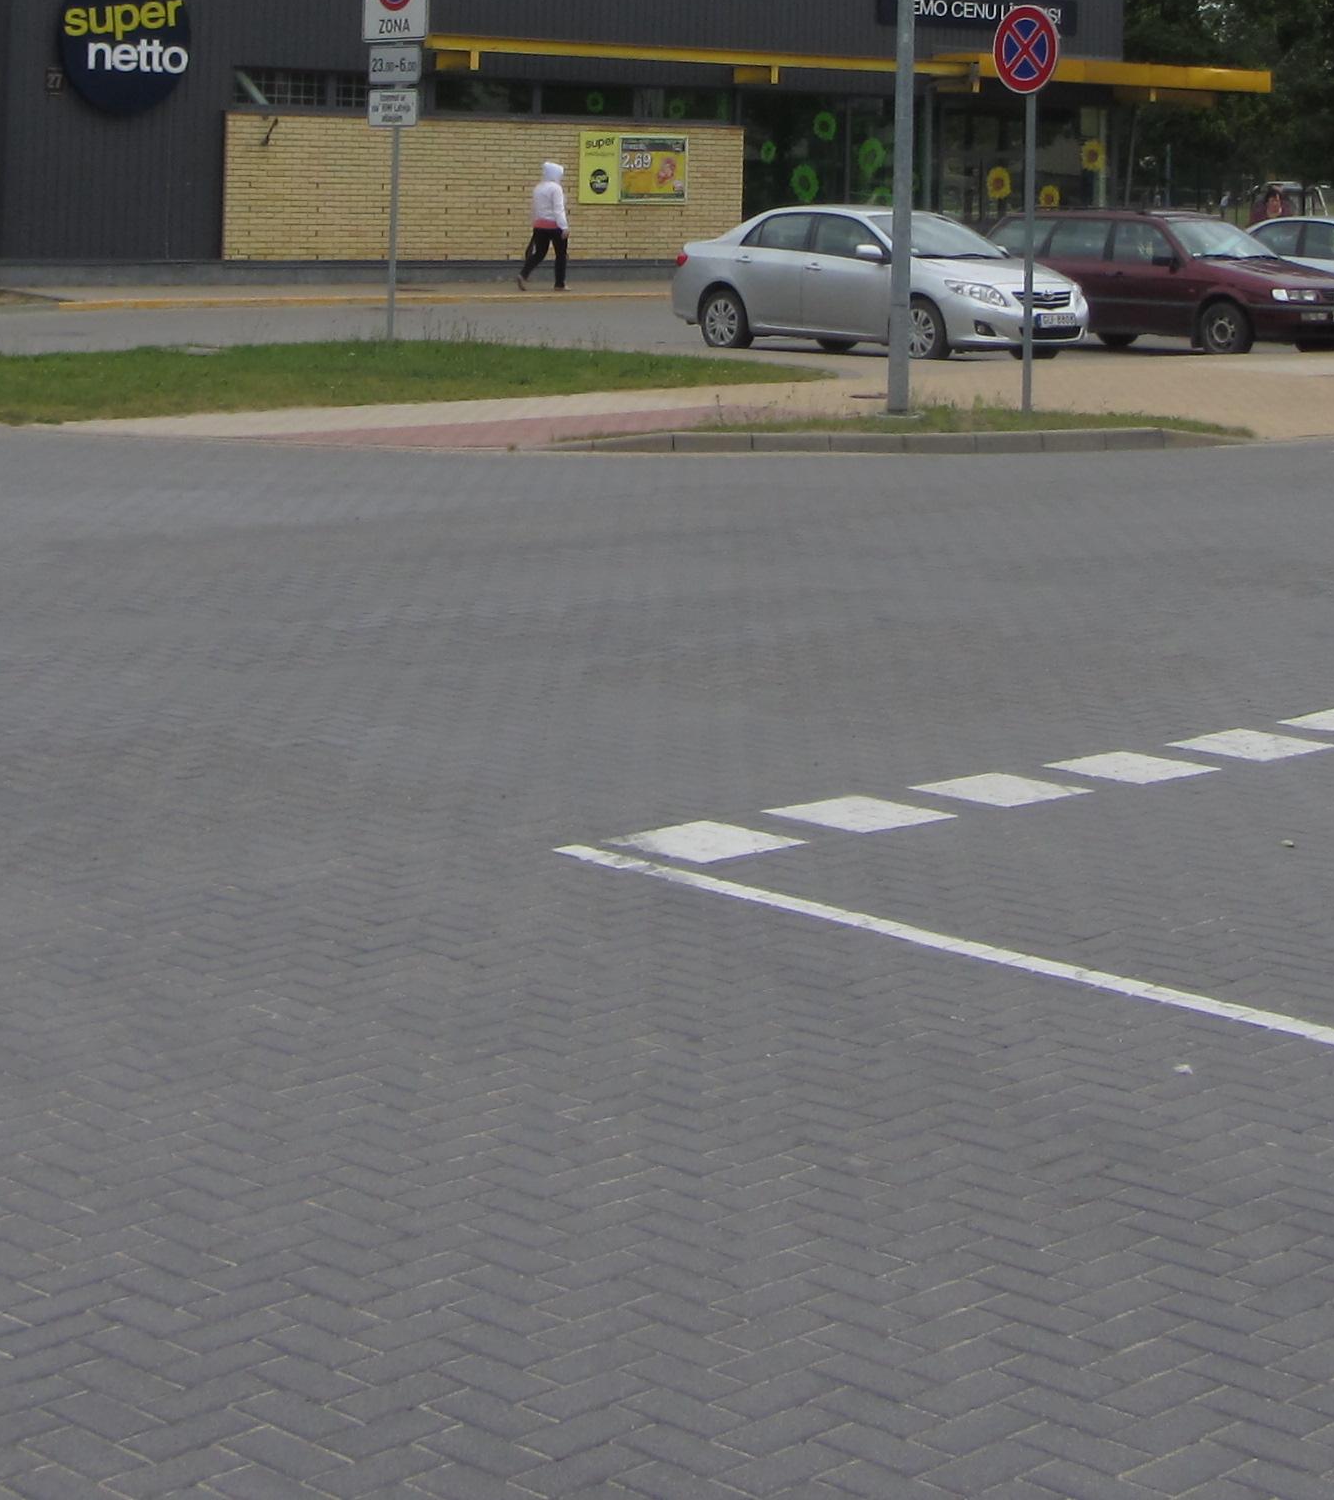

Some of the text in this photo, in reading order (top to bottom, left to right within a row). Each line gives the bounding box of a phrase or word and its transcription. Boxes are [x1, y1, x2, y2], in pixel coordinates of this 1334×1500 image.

[951, 1, 997, 20] CENU
[64, 0, 183, 39] super
[379, 19, 410, 34] ZONA
[87, 38, 188, 75] netto
[47, 73, 63, 89] 27
[585, 137, 615, 149] super
